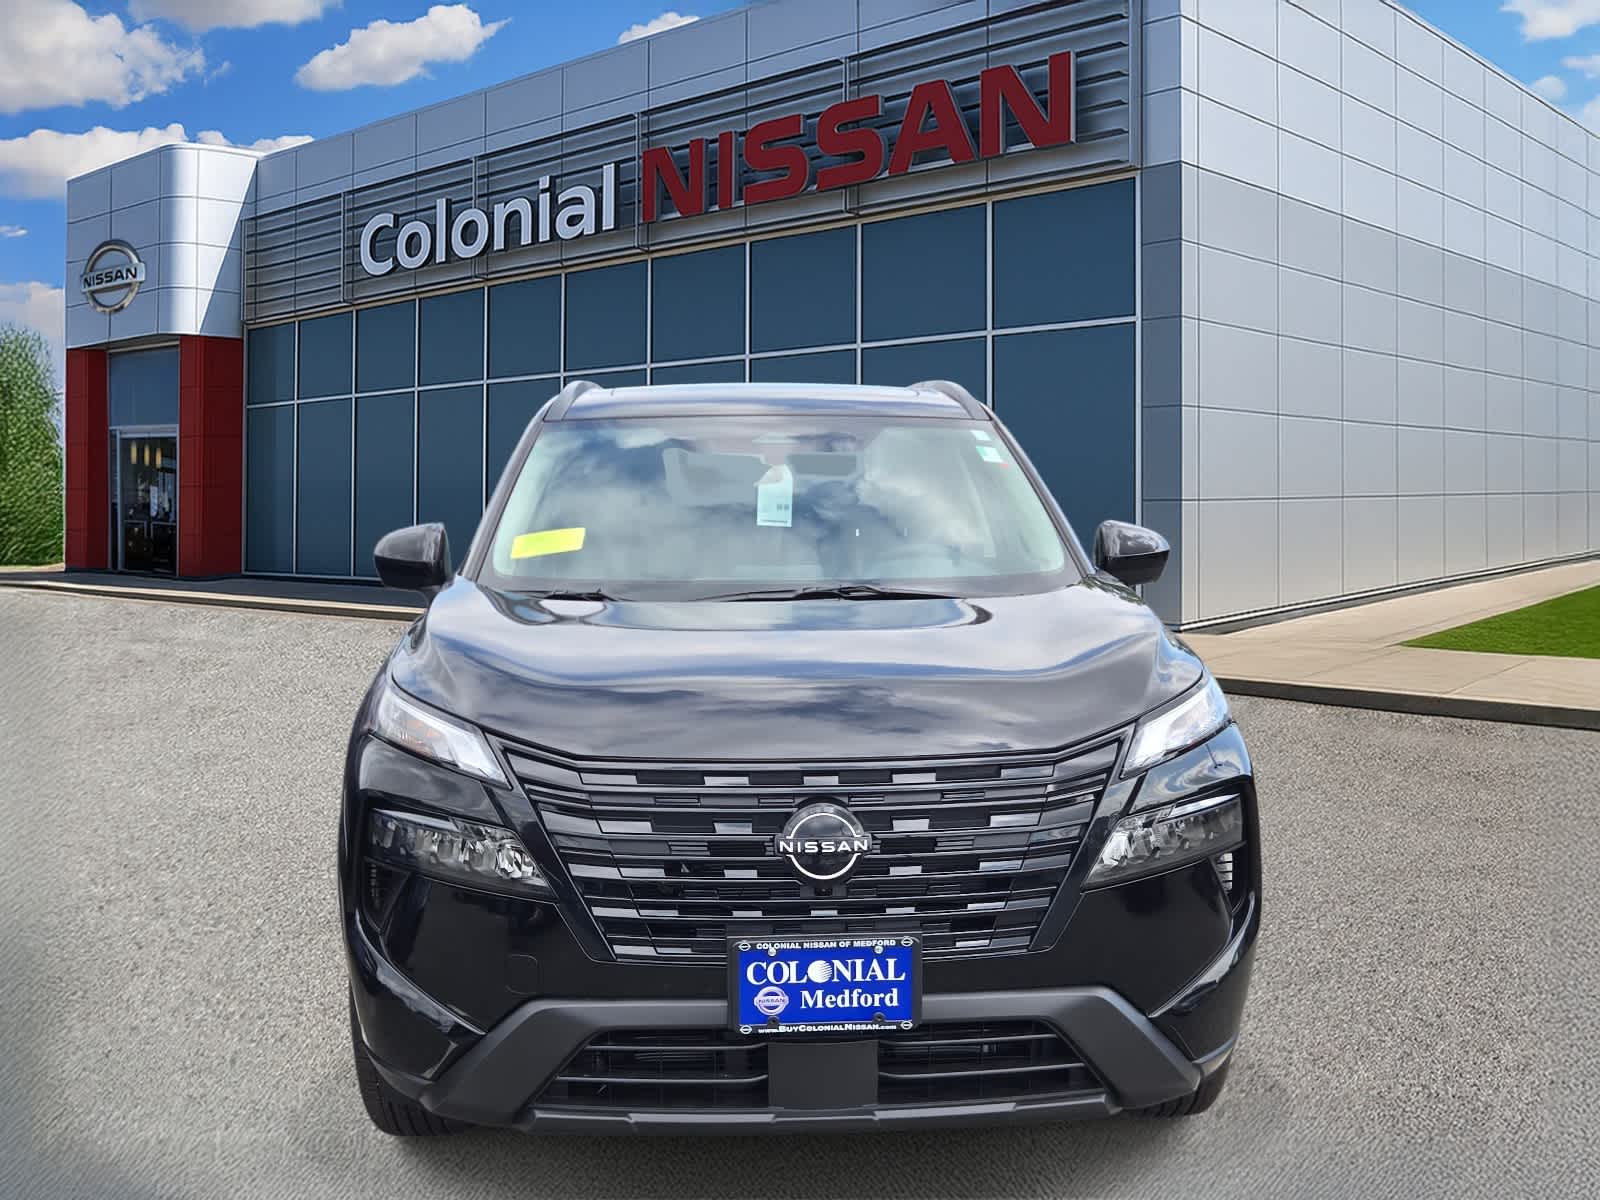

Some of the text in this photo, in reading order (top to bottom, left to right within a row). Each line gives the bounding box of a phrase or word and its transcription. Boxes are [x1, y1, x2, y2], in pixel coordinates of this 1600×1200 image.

[360, 50, 1075, 276] Colonial NISSAN
[83, 266, 138, 289] NISSAN
[779, 839, 868, 853] NISSAN
[756, 942, 802, 950] COLONIAL
[803, 941, 837, 949] NISSAN
[853, 939, 896, 947] MEDFORD
[746, 958, 906, 985] COLONIAL
[800, 988, 899, 1009] Medford
